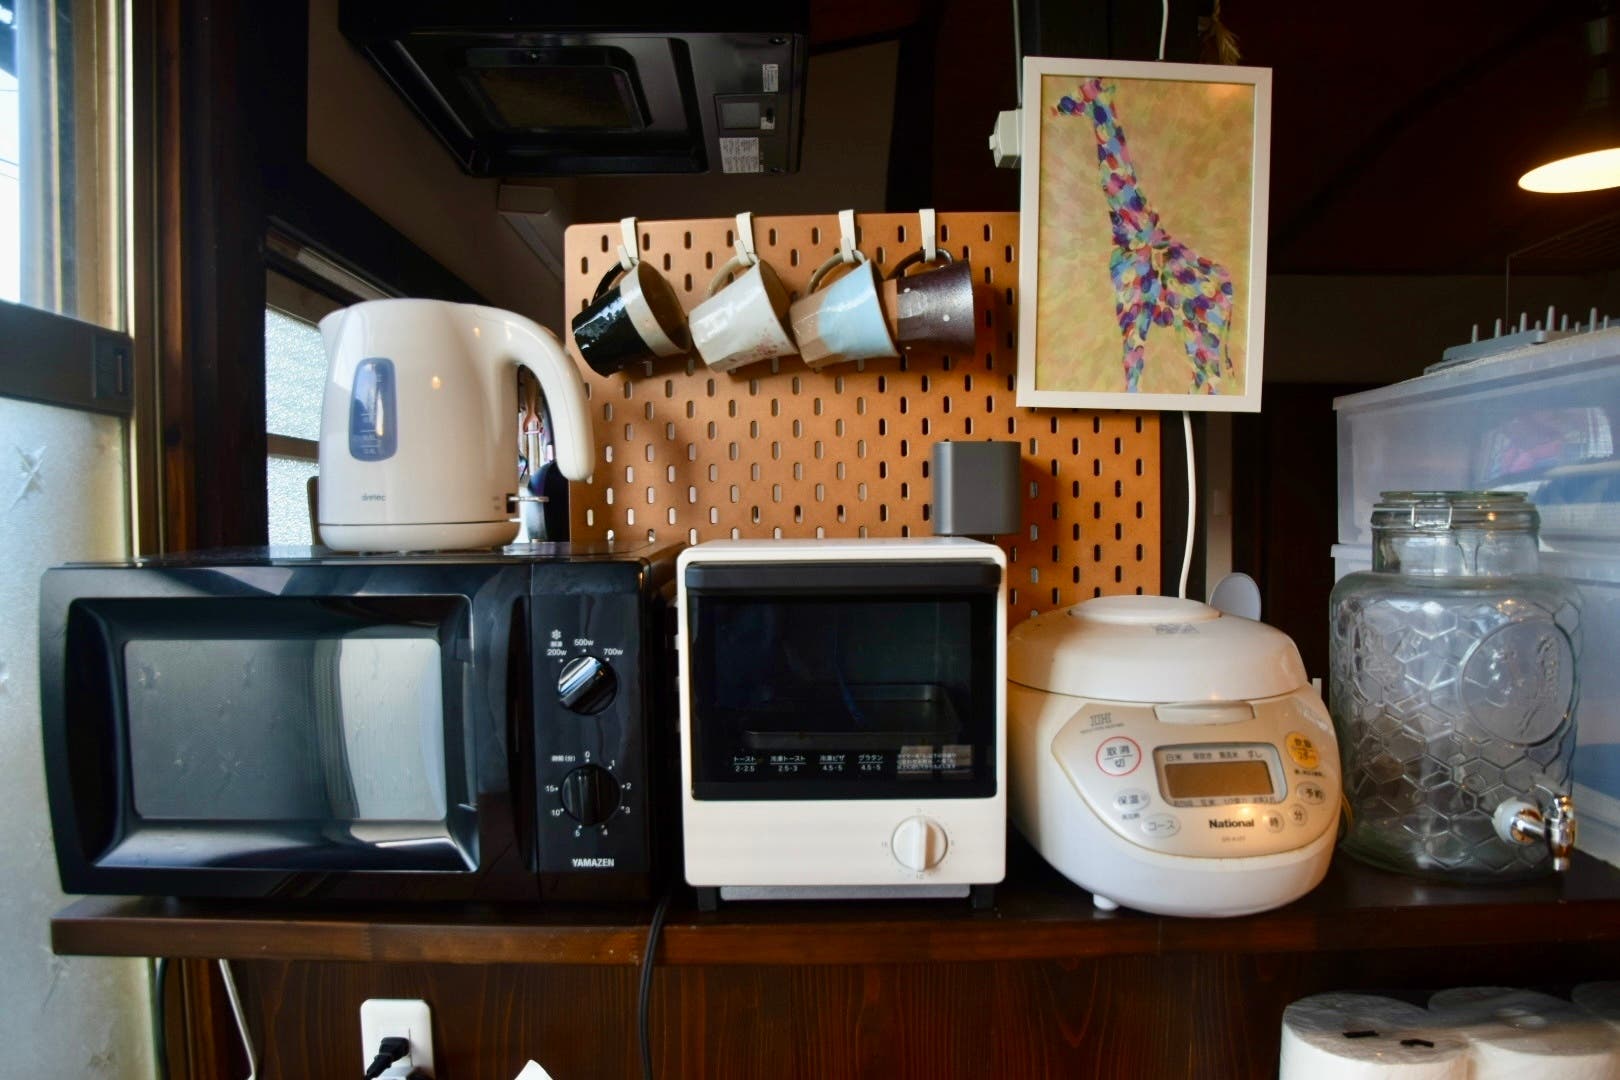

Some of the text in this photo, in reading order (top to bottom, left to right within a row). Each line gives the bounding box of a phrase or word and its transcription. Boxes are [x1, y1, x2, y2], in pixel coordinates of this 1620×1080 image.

[1106, 745, 1130, 756] 取消
[1149, 821, 1175, 831] コース
[1209, 819, 1255, 828] National
[572, 858, 615, 868] YAMAZEN
